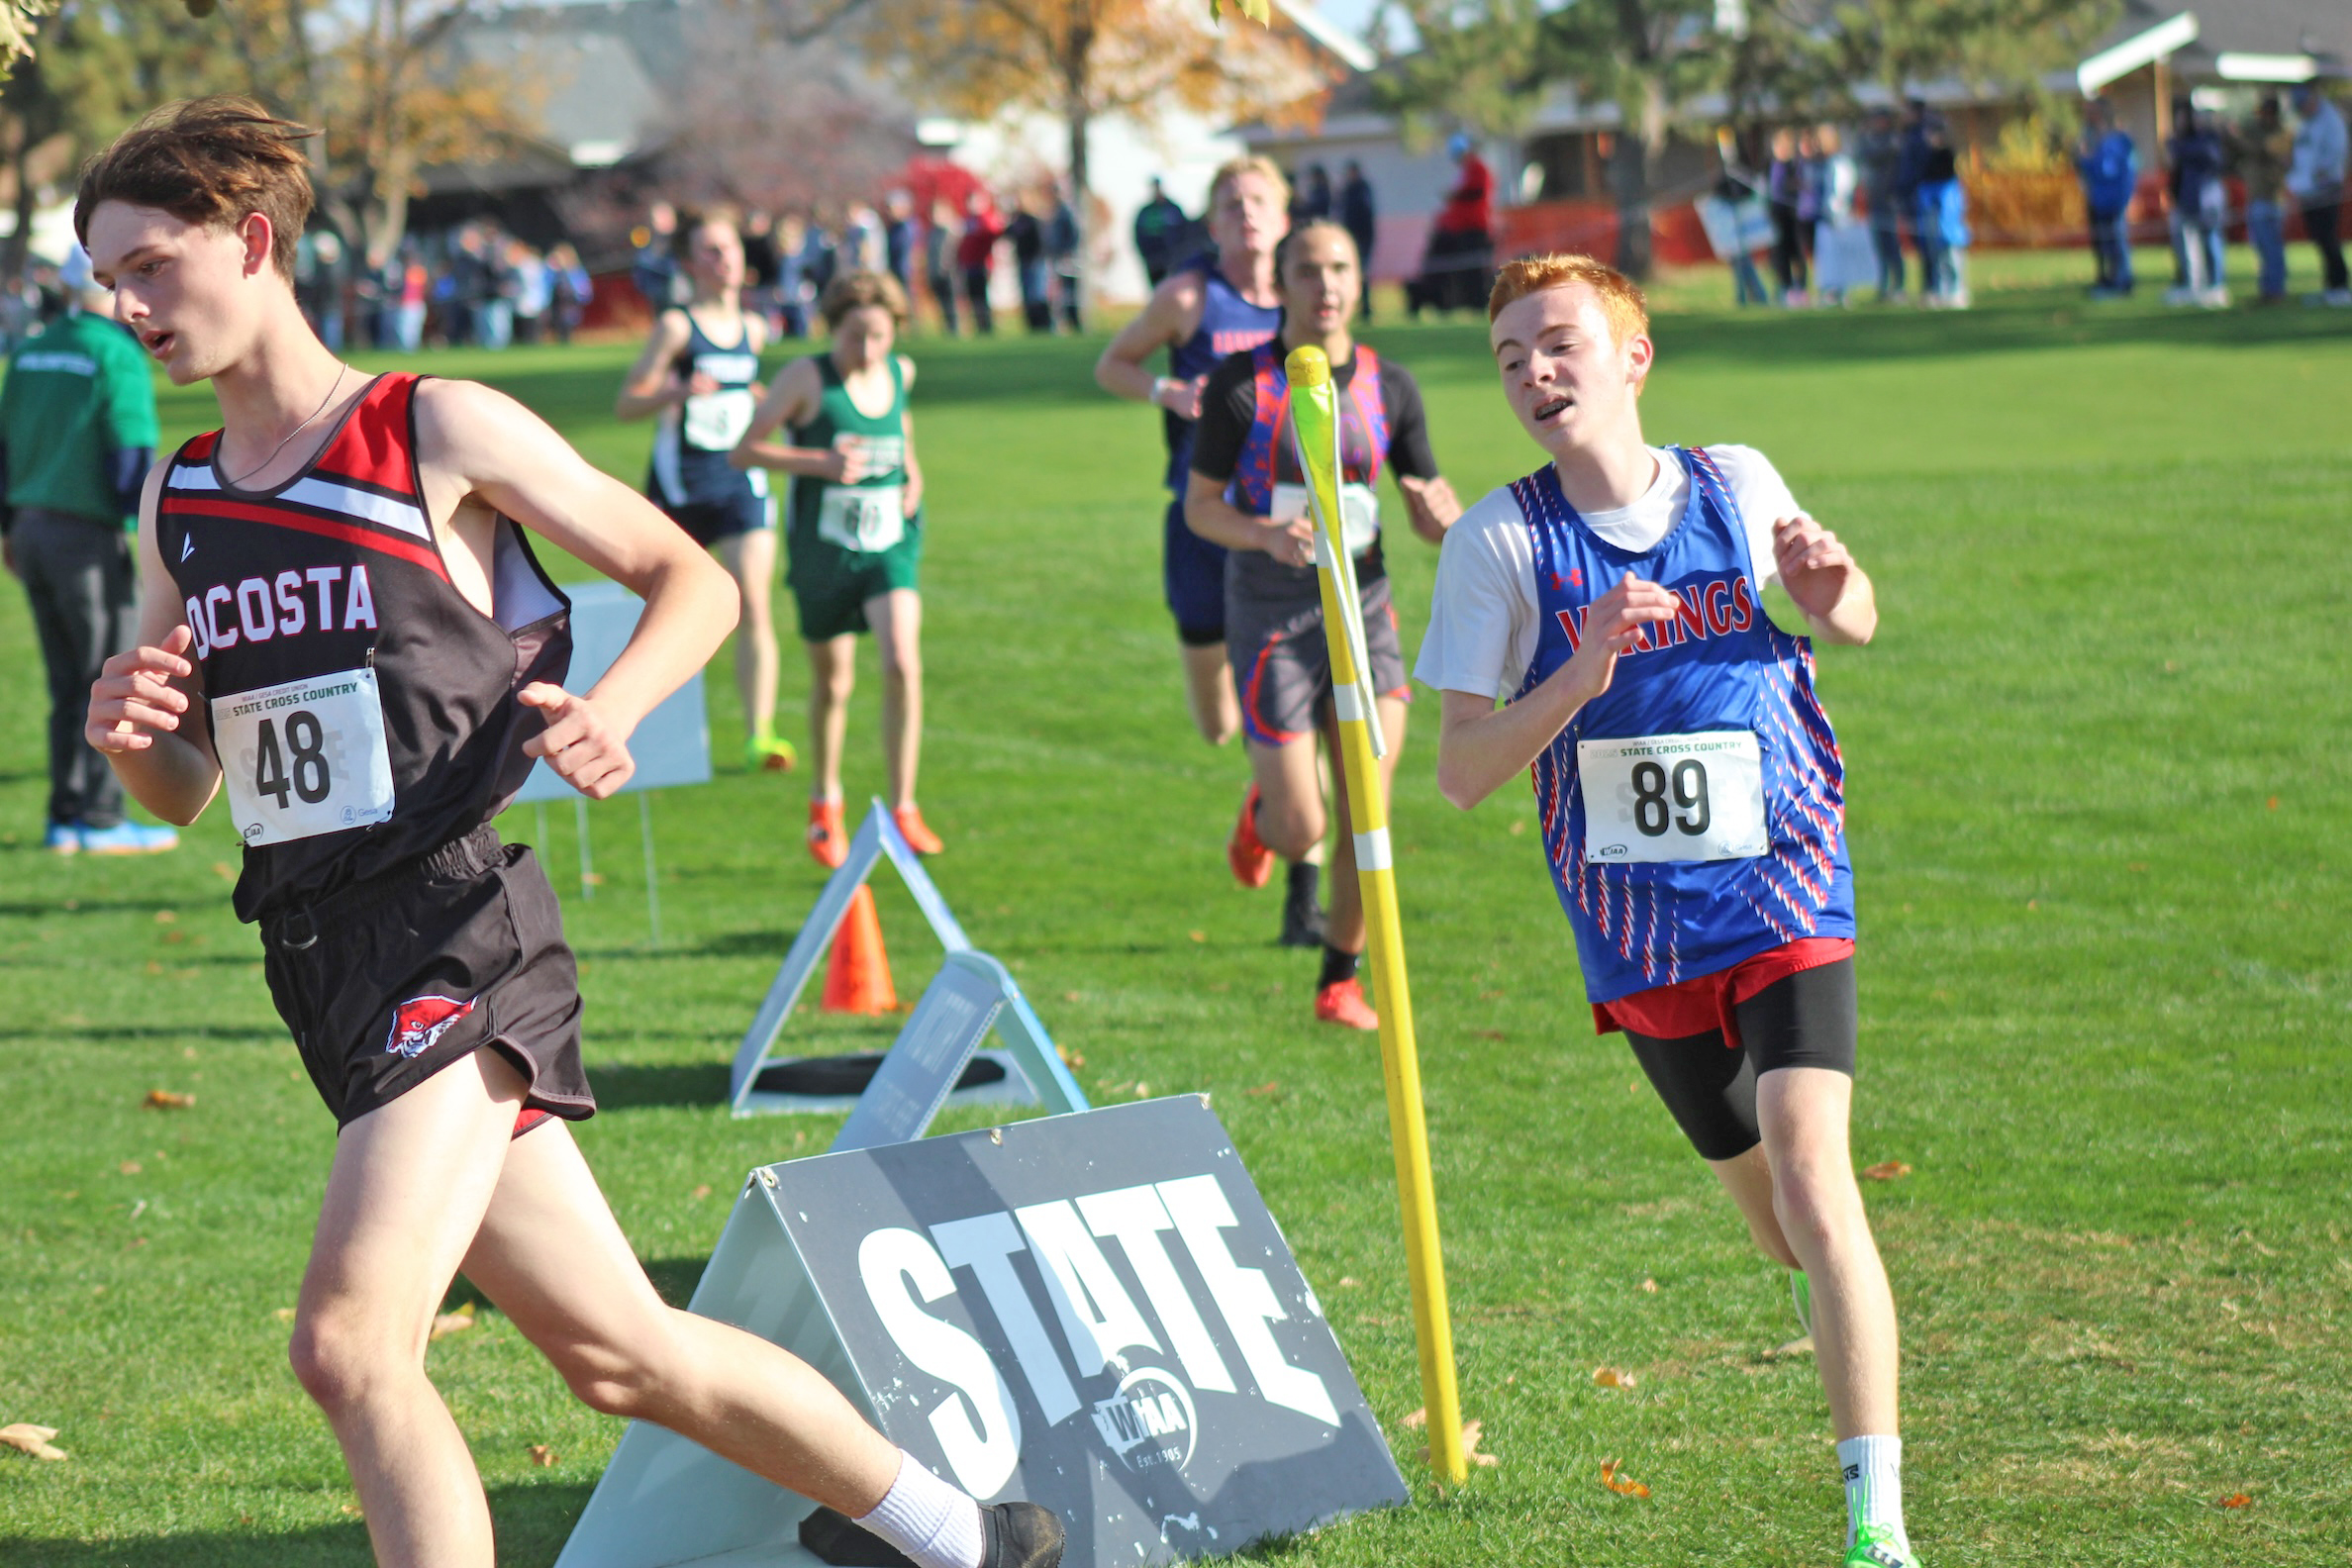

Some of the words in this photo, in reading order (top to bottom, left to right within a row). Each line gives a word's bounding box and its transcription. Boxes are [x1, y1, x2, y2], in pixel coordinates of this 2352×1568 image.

[185, 564, 378, 661] OCOSTA
[1555, 576, 1753, 657] VINGS
[233, 702, 262, 717] STATE
[265, 694, 300, 710] CROSS
[303, 682, 358, 702] COUNTRY
[256, 710, 331, 810] 48
[1620, 746, 1653, 757] STATE
[1656, 744, 1691, 755] CROSS
[1694, 741, 1742, 752] COUNTRY
[1630, 758, 1711, 837] 89
[1602, 847, 1624, 856] WIAA
[857, 1173, 1341, 1501] STATE
[1105, 1392, 1188, 1443] WIAA
